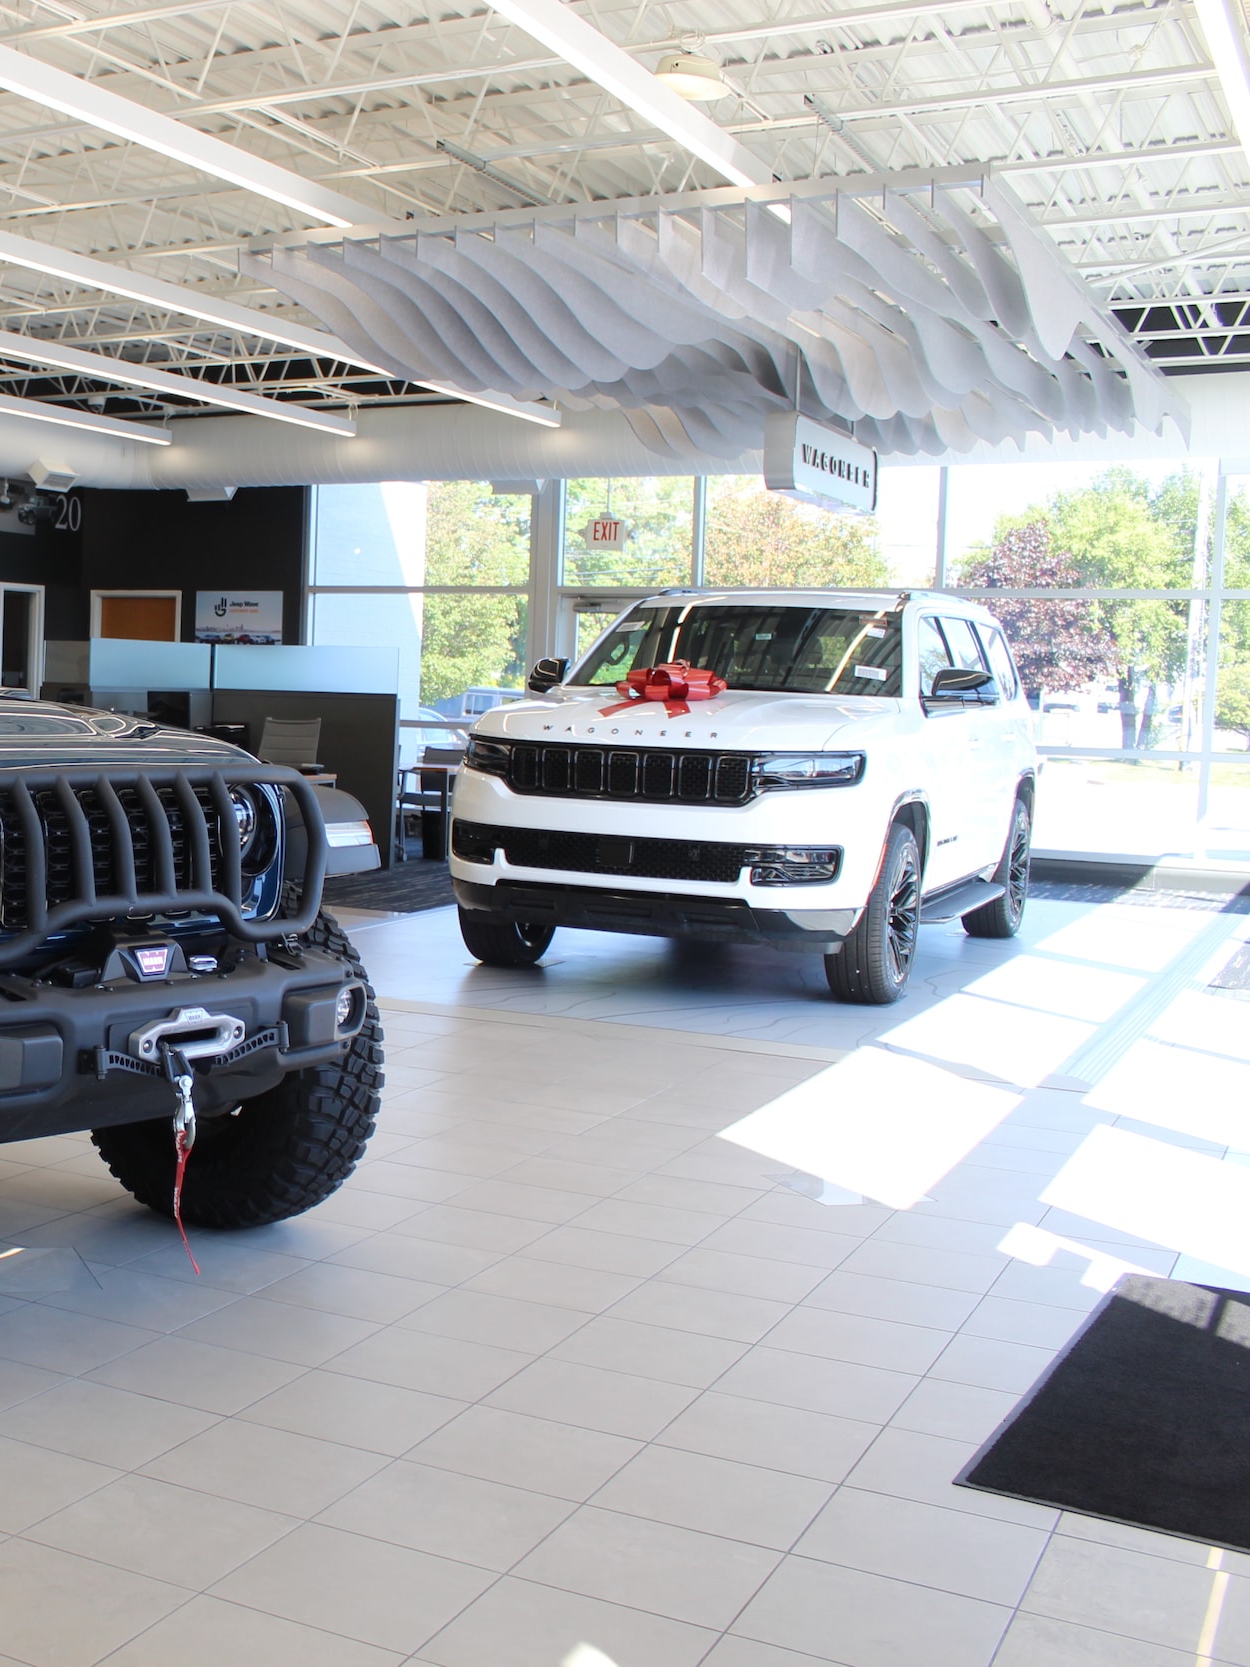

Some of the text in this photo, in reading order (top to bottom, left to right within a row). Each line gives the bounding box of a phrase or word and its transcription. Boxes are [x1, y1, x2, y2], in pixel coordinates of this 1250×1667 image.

[55, 494, 82, 532] 20
[593, 521, 620, 542] EXIT
[542, 724, 718, 739] WAGONEER
